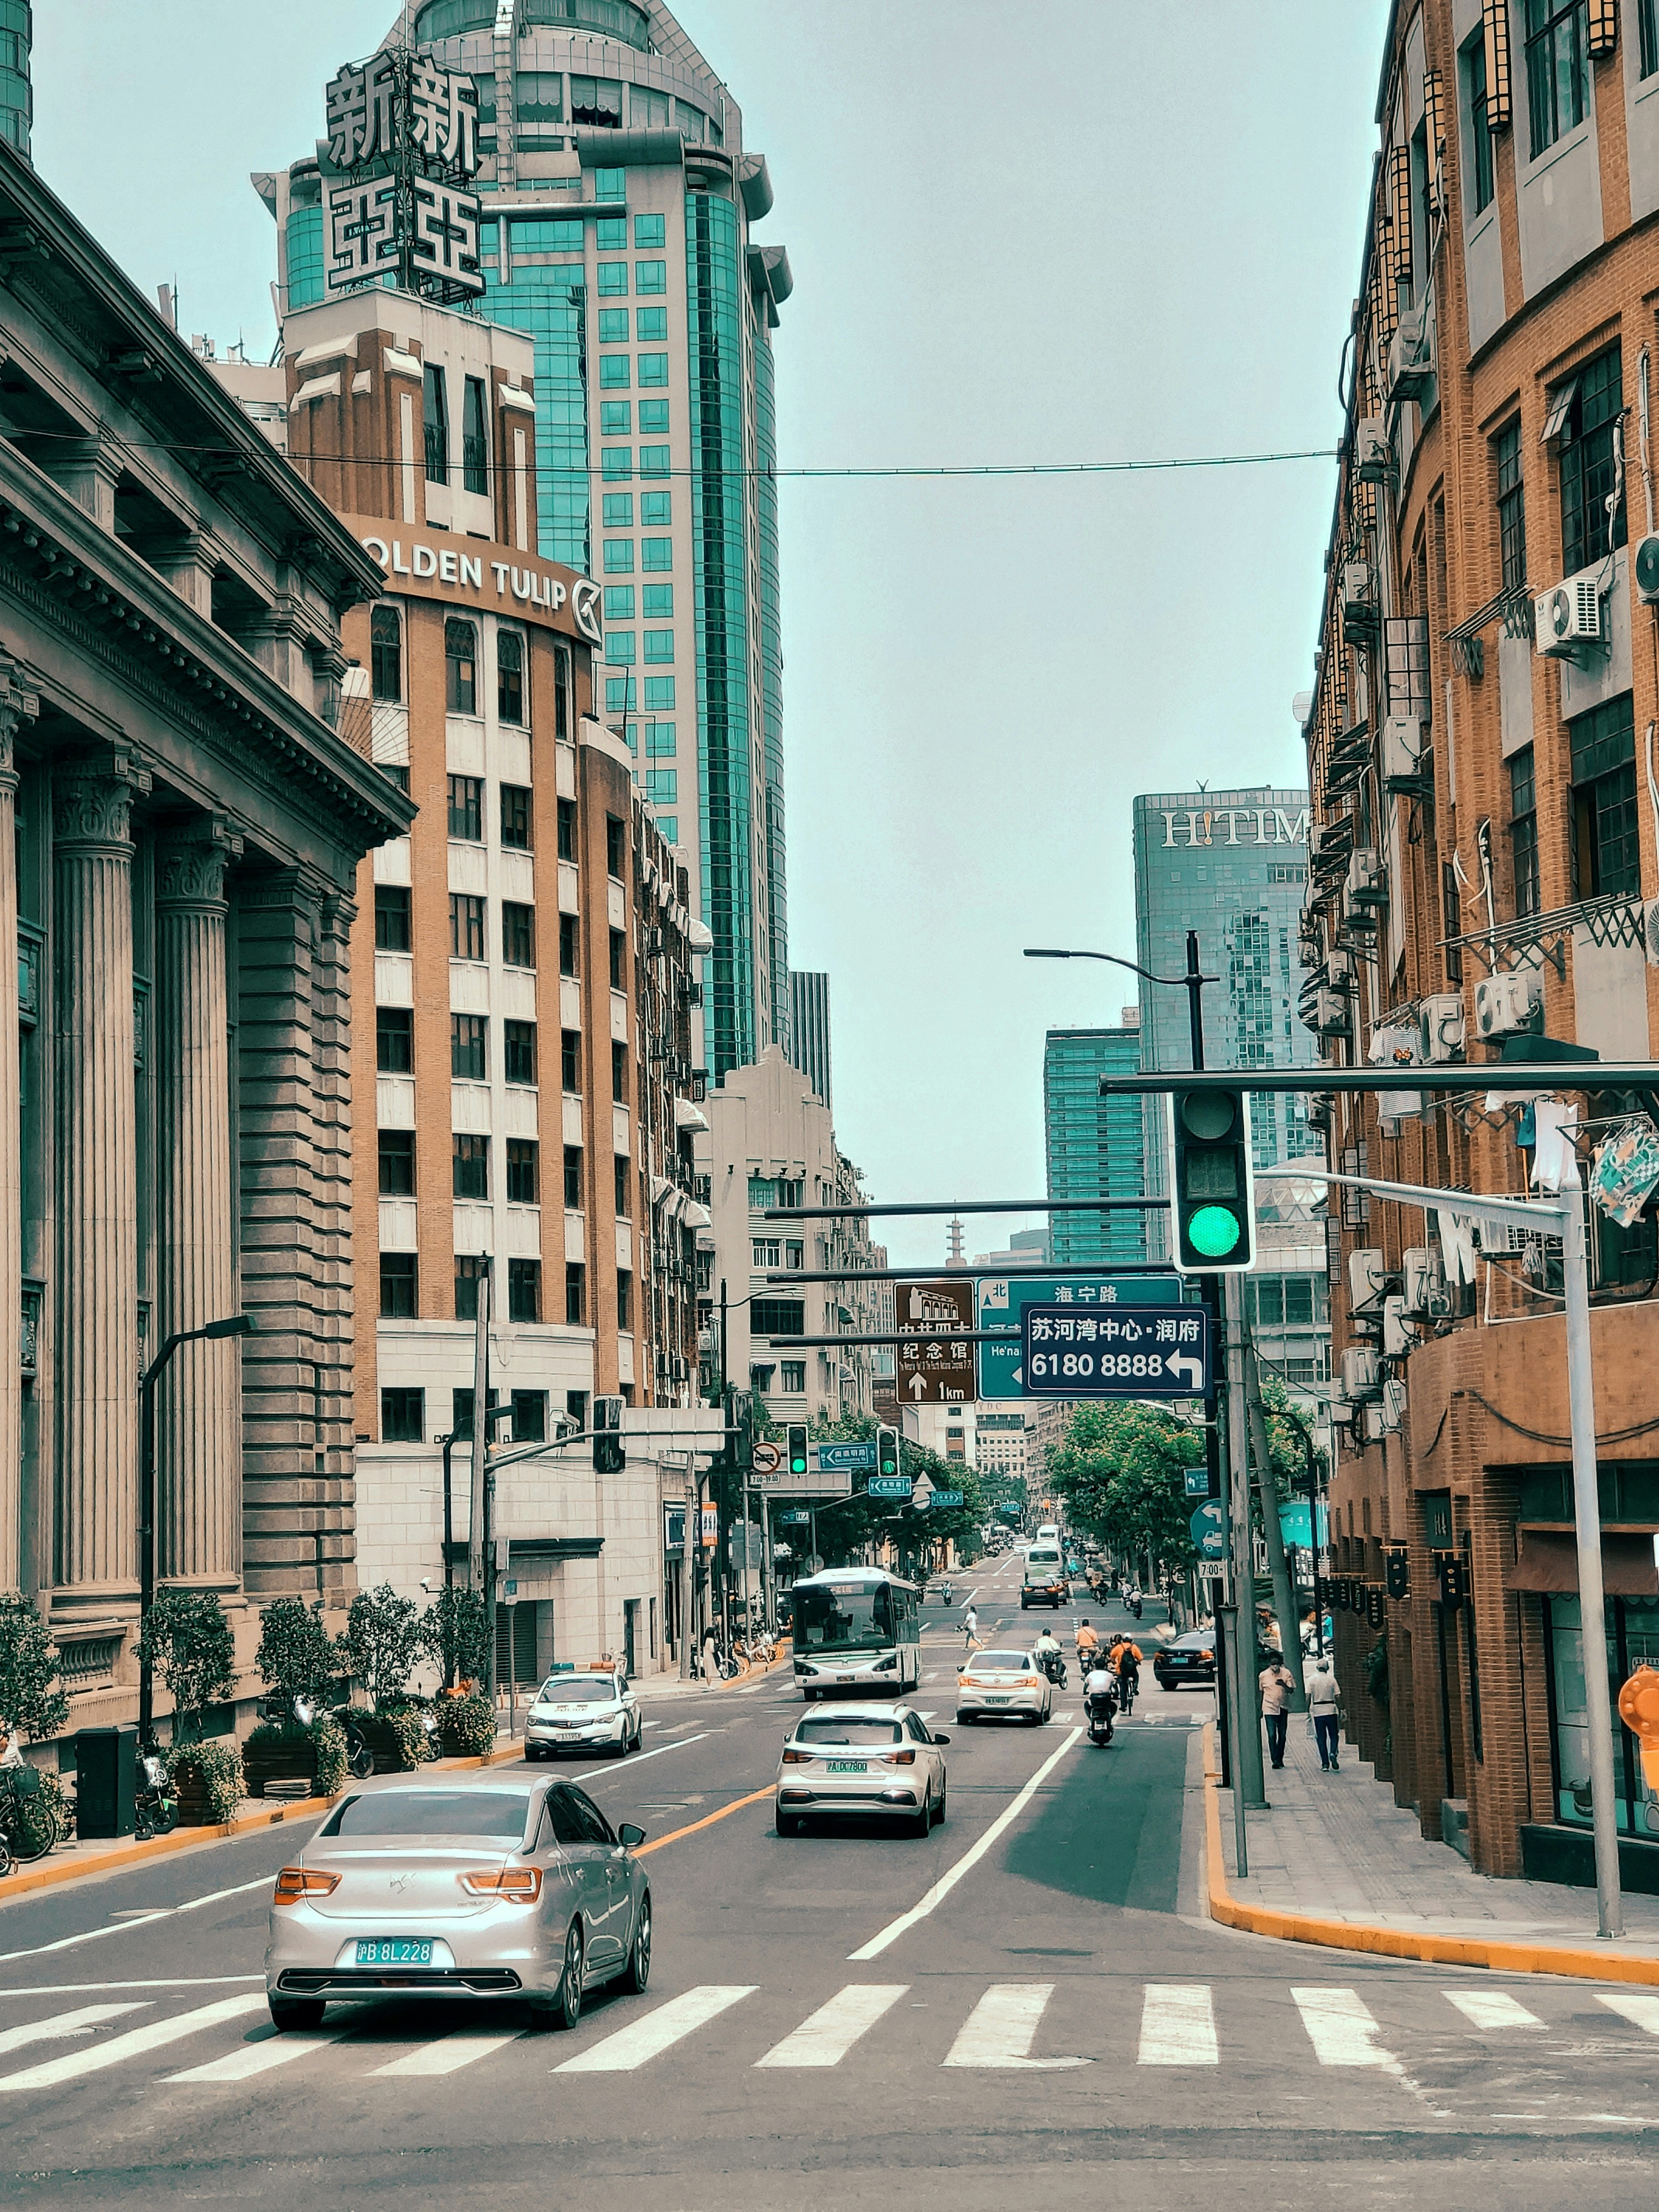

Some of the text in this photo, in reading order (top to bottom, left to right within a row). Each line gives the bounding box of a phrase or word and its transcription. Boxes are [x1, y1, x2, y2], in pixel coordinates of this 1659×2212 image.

[490, 561, 566, 609] TULIP
[992, 1284, 1006, 1297] 北
[902, 1342, 967, 1359] 纪念馆
[1032, 1353, 1162, 1376] 6180 8888
